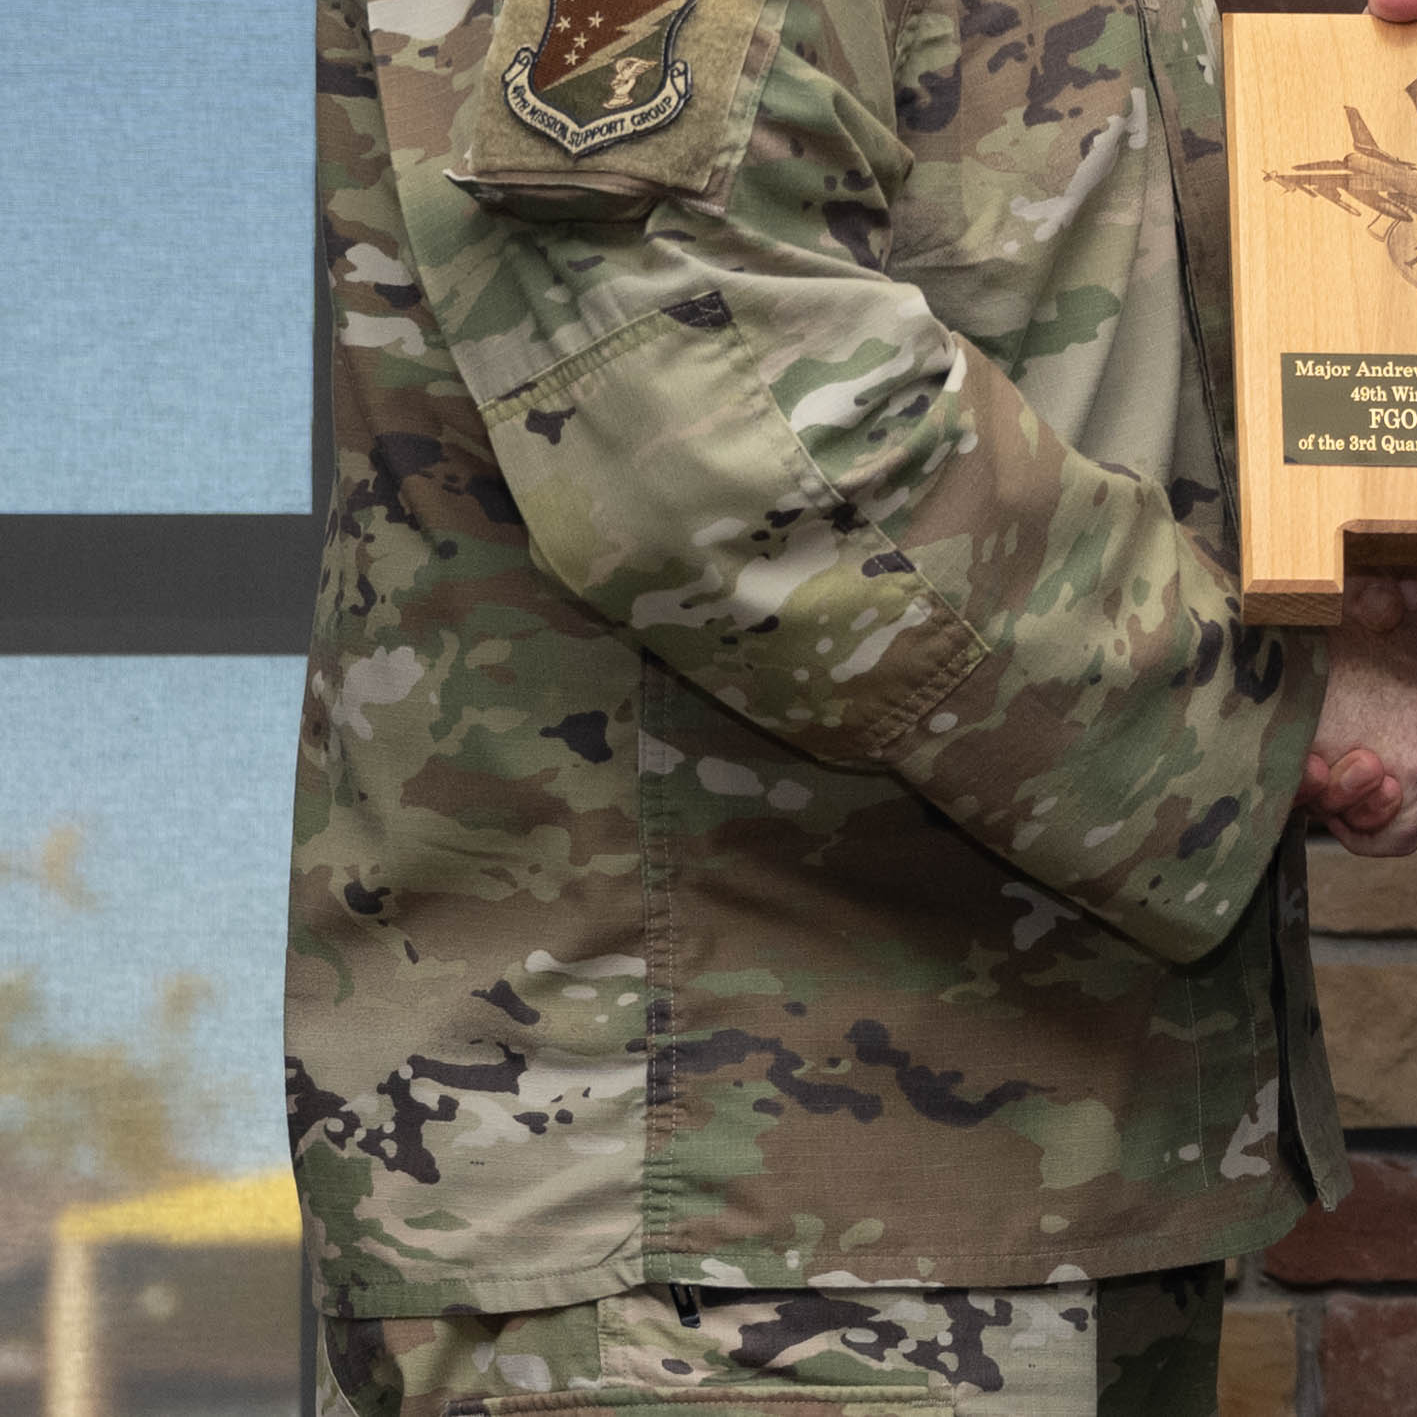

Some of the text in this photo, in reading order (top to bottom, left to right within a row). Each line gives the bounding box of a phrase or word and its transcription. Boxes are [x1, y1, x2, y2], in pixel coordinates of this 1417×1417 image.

[529, 104, 569, 142] MISSION
[568, 117, 626, 148] SUPPORT
[630, 96, 673, 127] GROUP
[1294, 360, 1351, 380] Major
[1350, 385, 1388, 402] 49th
[1298, 434, 1316, 451] of
[1317, 434, 1345, 451] the
[1349, 435, 1377, 451] 3rd
